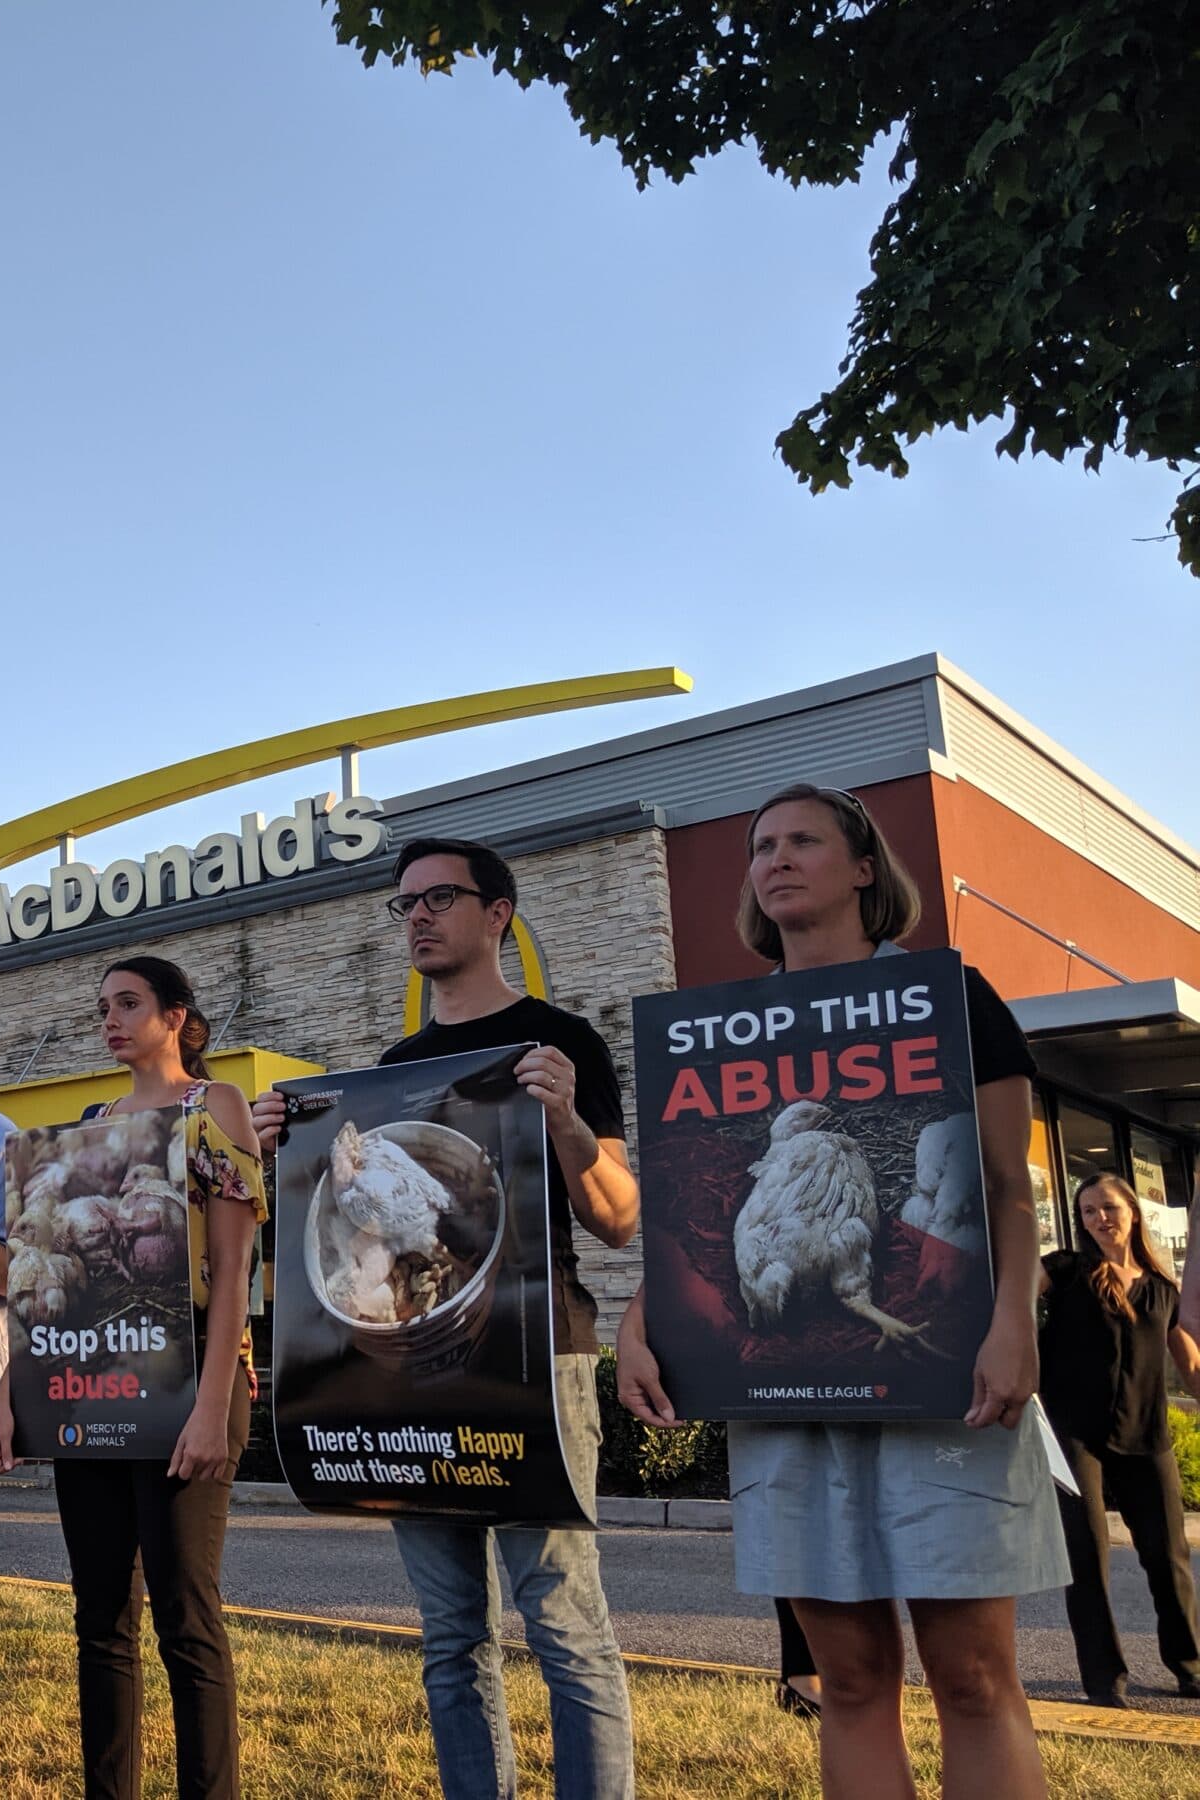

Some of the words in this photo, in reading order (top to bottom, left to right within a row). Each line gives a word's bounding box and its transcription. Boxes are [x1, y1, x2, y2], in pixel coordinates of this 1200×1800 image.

[667, 1005, 795, 1054] STOP
[810, 984, 934, 1034] THIS
[661, 1036, 944, 1123] ABUSE
[30, 1325, 98, 1362] Stop
[104, 1316, 167, 1352] this
[48, 1367, 147, 1400] abuse.
[753, 1387, 814, 1399] HUMANE
[818, 1386, 872, 1398] LEAGUE
[86, 1424, 116, 1434] MERCY
[118, 1423, 137, 1433] FOR
[86, 1436, 126, 1447] ANIMALS
[303, 1425, 374, 1452] There's
[379, 1426, 456, 1458] nothing
[457, 1426, 524, 1460] Happy
[311, 1457, 367, 1483] about
[368, 1458, 426, 1485] these
[432, 1459, 511, 1486] Meals.
